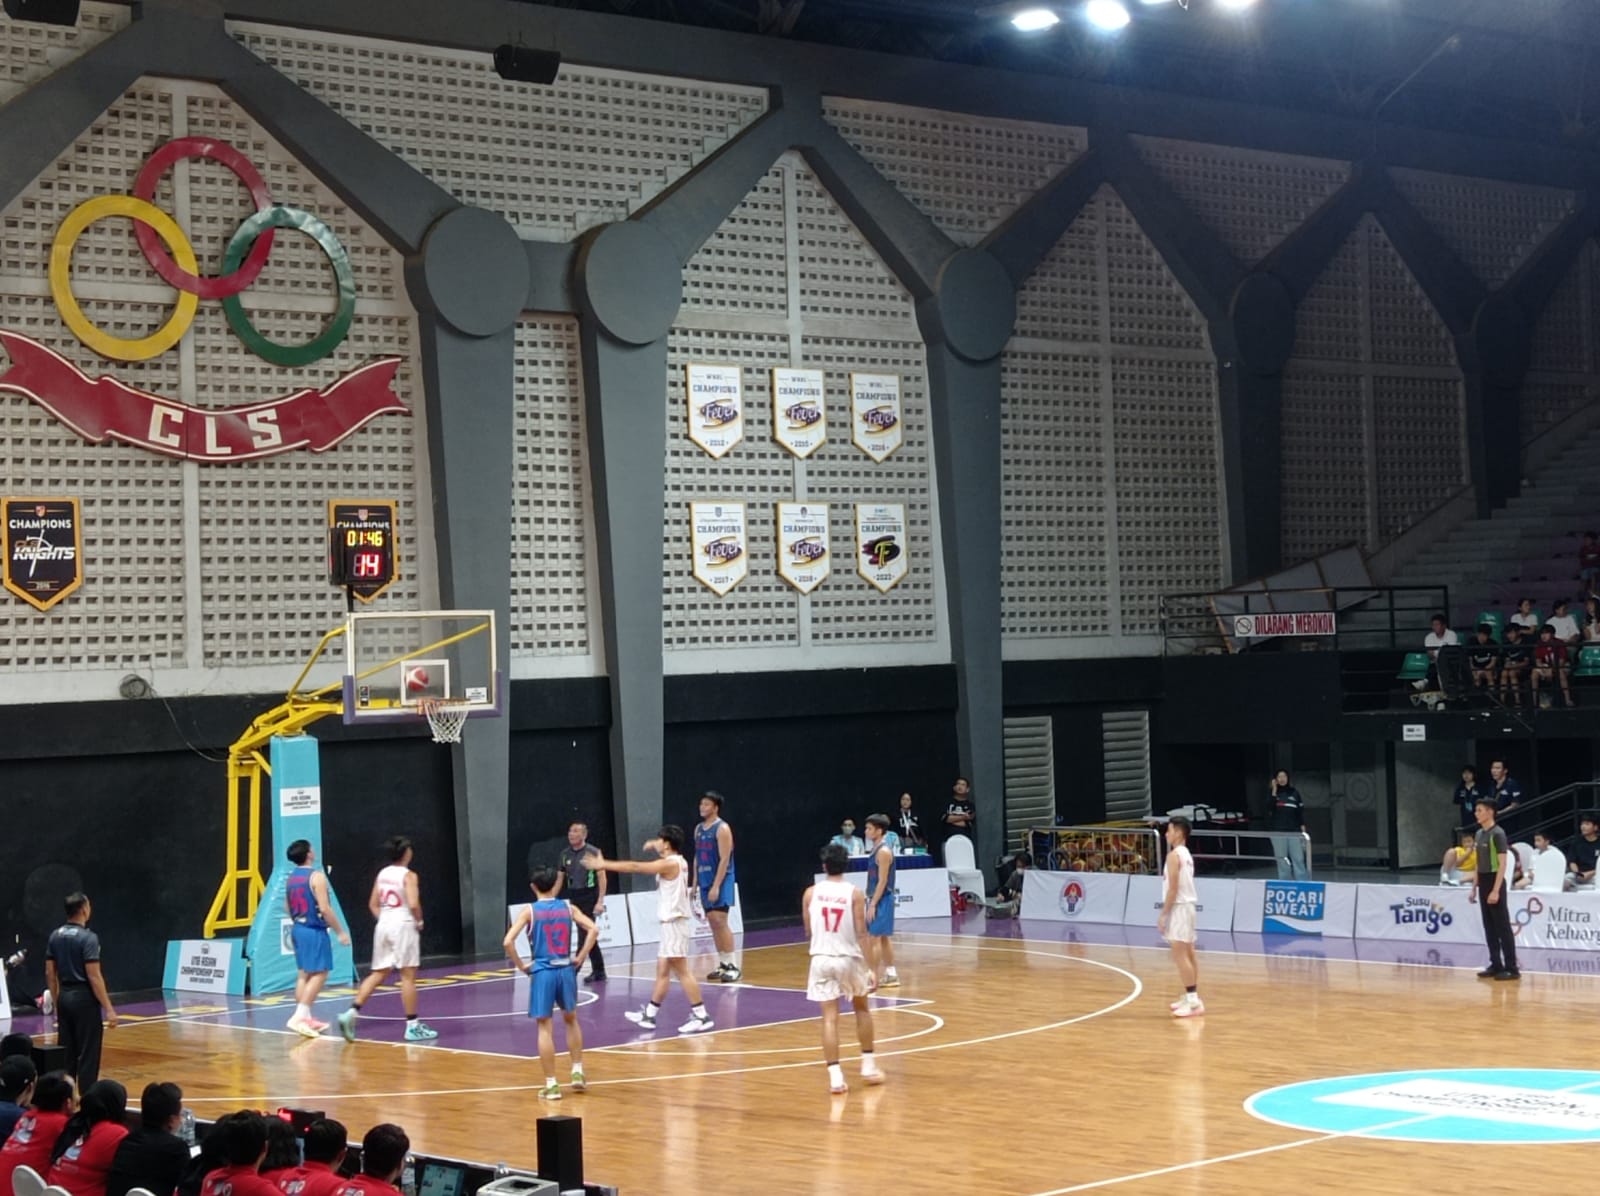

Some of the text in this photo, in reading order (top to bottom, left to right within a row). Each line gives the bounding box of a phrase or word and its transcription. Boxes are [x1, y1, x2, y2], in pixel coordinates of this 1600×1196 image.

[692, 384, 737, 394] CHAMPIONS
[778, 387, 821, 396] CHAMPIONS
[855, 392, 897, 401] CHAMPIONS
[148, 403, 282, 454] CLS
[9, 519, 72, 529] CHAMPIONS
[336, 521, 390, 529] CHAMPIONS
[696, 525, 742, 534] CHAMPIONS
[783, 525, 826, 533] CHAMPIONS
[861, 525, 902, 533] CHAMPIONS
[347, 530, 383, 547] 01:46
[13, 546, 76, 561] KNIGHTS
[360, 553, 380, 577] 14
[1255, 613, 1334, 635] DILARANG MEROKOK
[1266, 890, 1323, 905] POCARI
[1405, 896, 1430, 907] Susu
[1265, 902, 1318, 917] SWEAT
[1548, 906, 1591, 923] Mitra
[822, 906, 844, 933] 17
[1389, 903, 1453, 935] Tango
